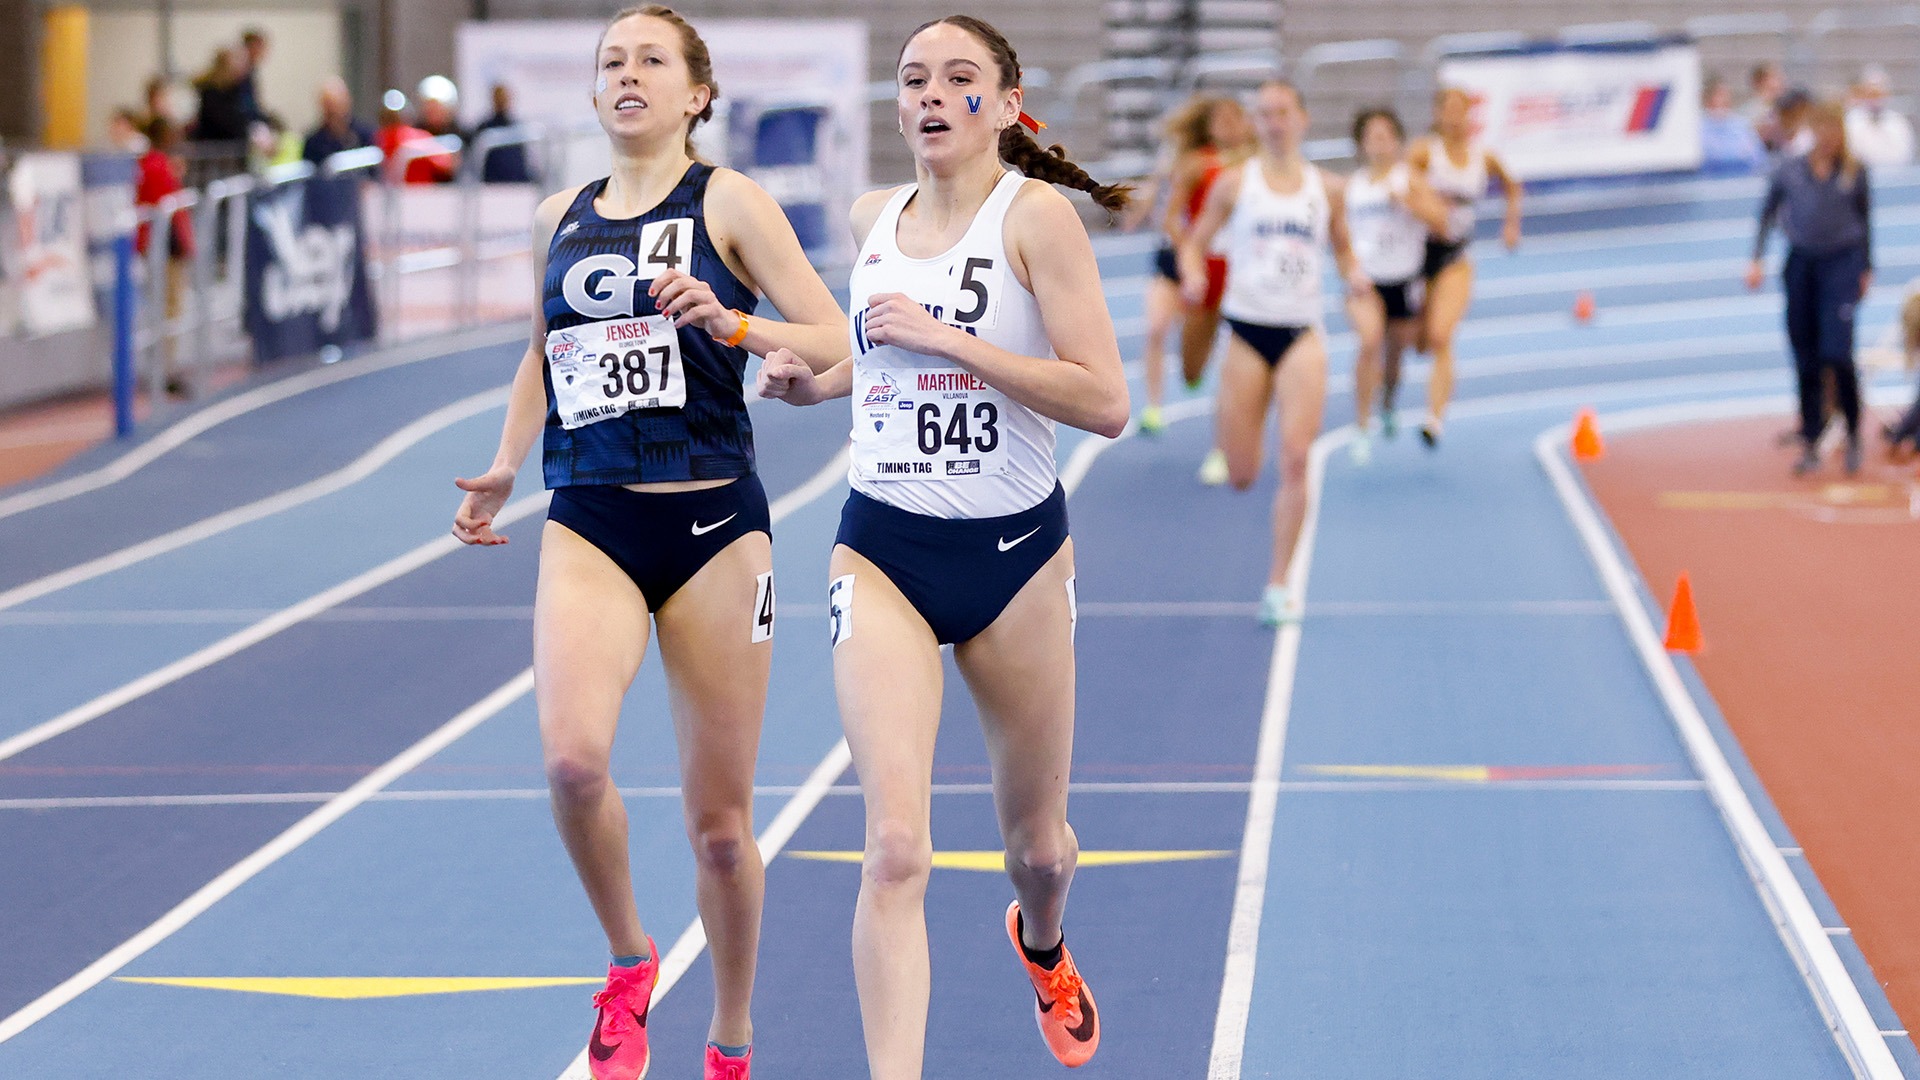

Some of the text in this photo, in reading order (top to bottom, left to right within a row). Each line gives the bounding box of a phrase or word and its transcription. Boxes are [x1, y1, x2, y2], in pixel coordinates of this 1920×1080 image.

[965, 95, 982, 114] V
[647, 223, 682, 269] 4
[563, 254, 637, 319] G
[954, 257, 993, 323] 5
[606, 321, 650, 342] JENSEN
[553, 342, 575, 353] BIG
[599, 345, 671, 399] 387
[864, 394, 897, 402] EAST
[869, 385, 891, 394] BIG
[942, 392, 969, 400] VILLANOVA
[573, 406, 600, 422] TIMING
[599, 403, 617, 415] TAG
[917, 402, 999, 455] 643
[877, 462, 932, 474] TIMING TAG
[947, 467, 979, 475] CHANGE
[758, 575, 773, 636] 4
